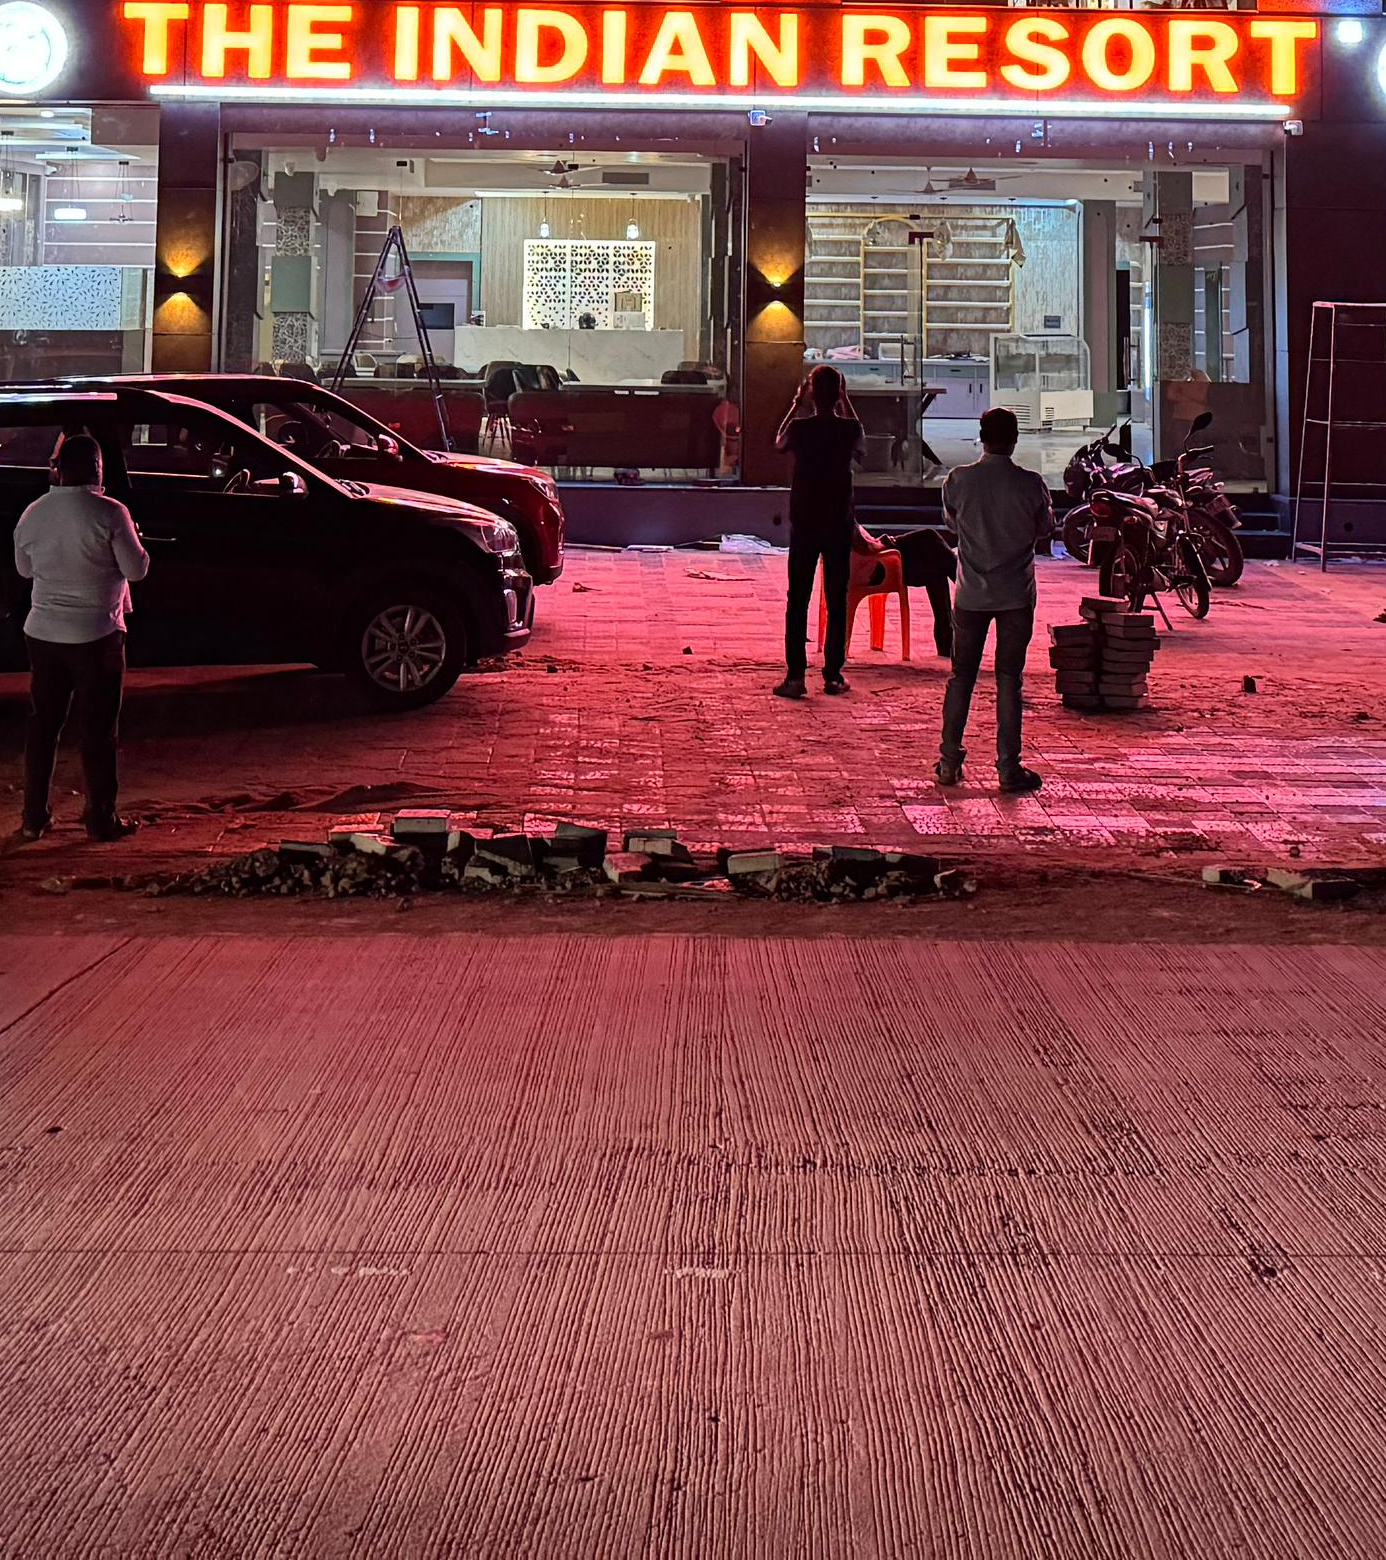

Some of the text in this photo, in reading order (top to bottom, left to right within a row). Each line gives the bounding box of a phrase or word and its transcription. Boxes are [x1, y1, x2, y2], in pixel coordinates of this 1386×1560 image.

[124, 1, 1317, 95] THE INDIAN RESORT
